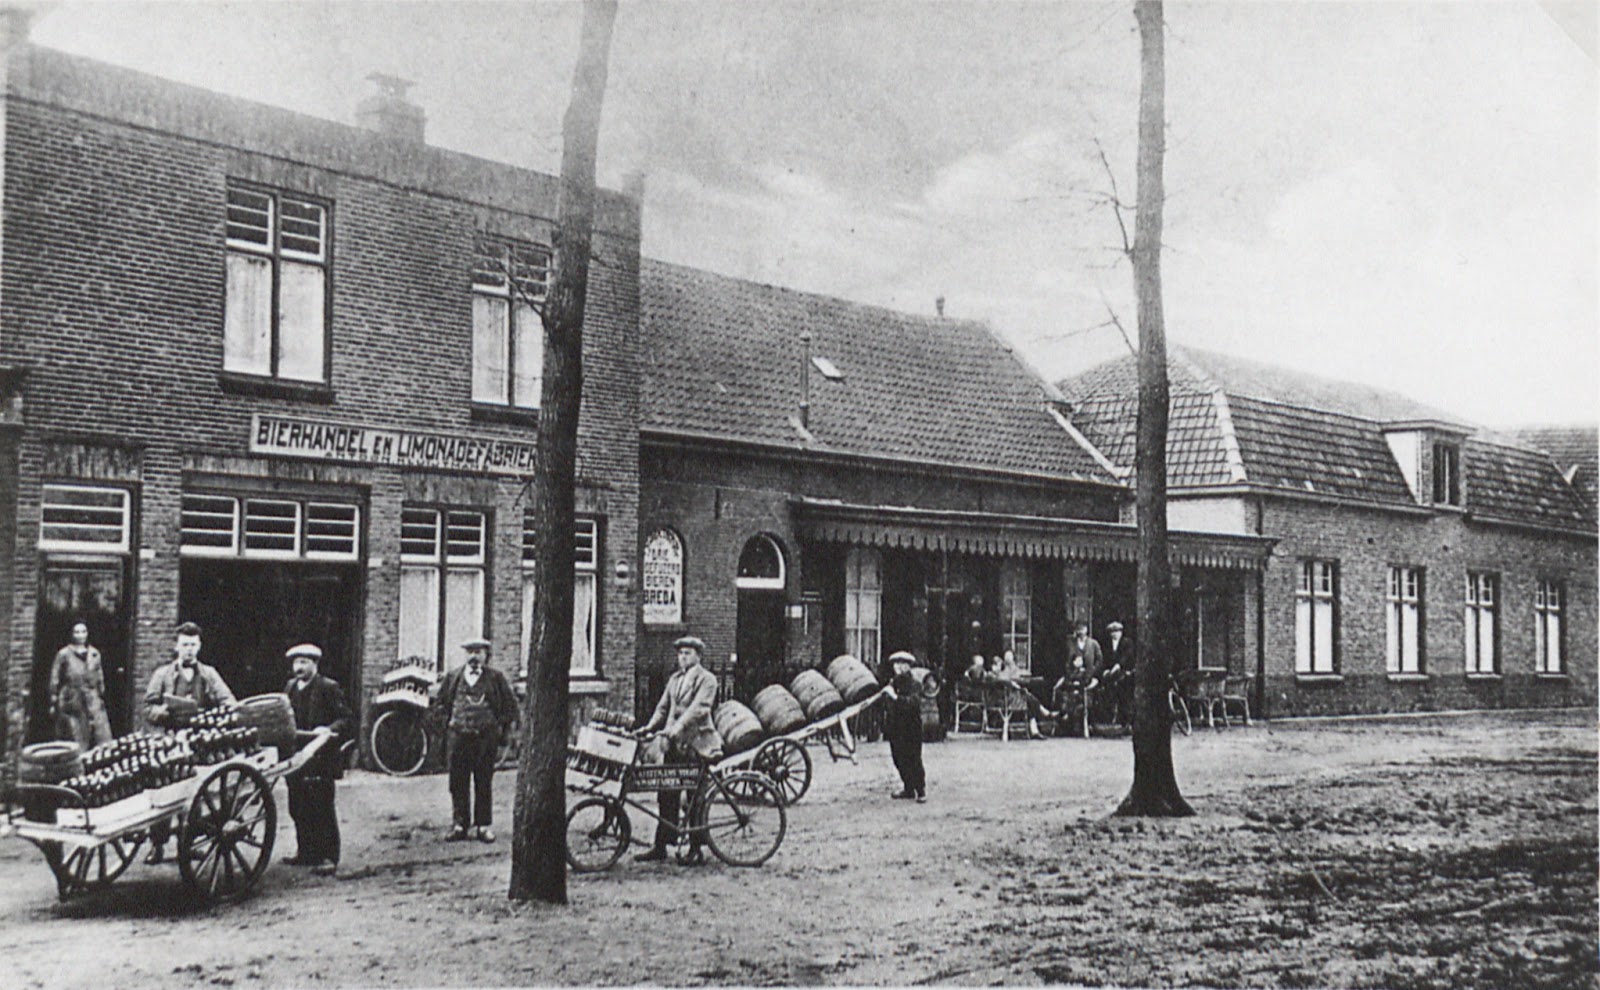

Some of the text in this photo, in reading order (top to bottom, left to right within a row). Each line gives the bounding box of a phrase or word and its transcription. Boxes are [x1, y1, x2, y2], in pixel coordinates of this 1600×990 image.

[257, 420, 368, 454] BIERHANDEL
[373, 435, 393, 455] EN
[643, 589, 676, 605] BREDA
